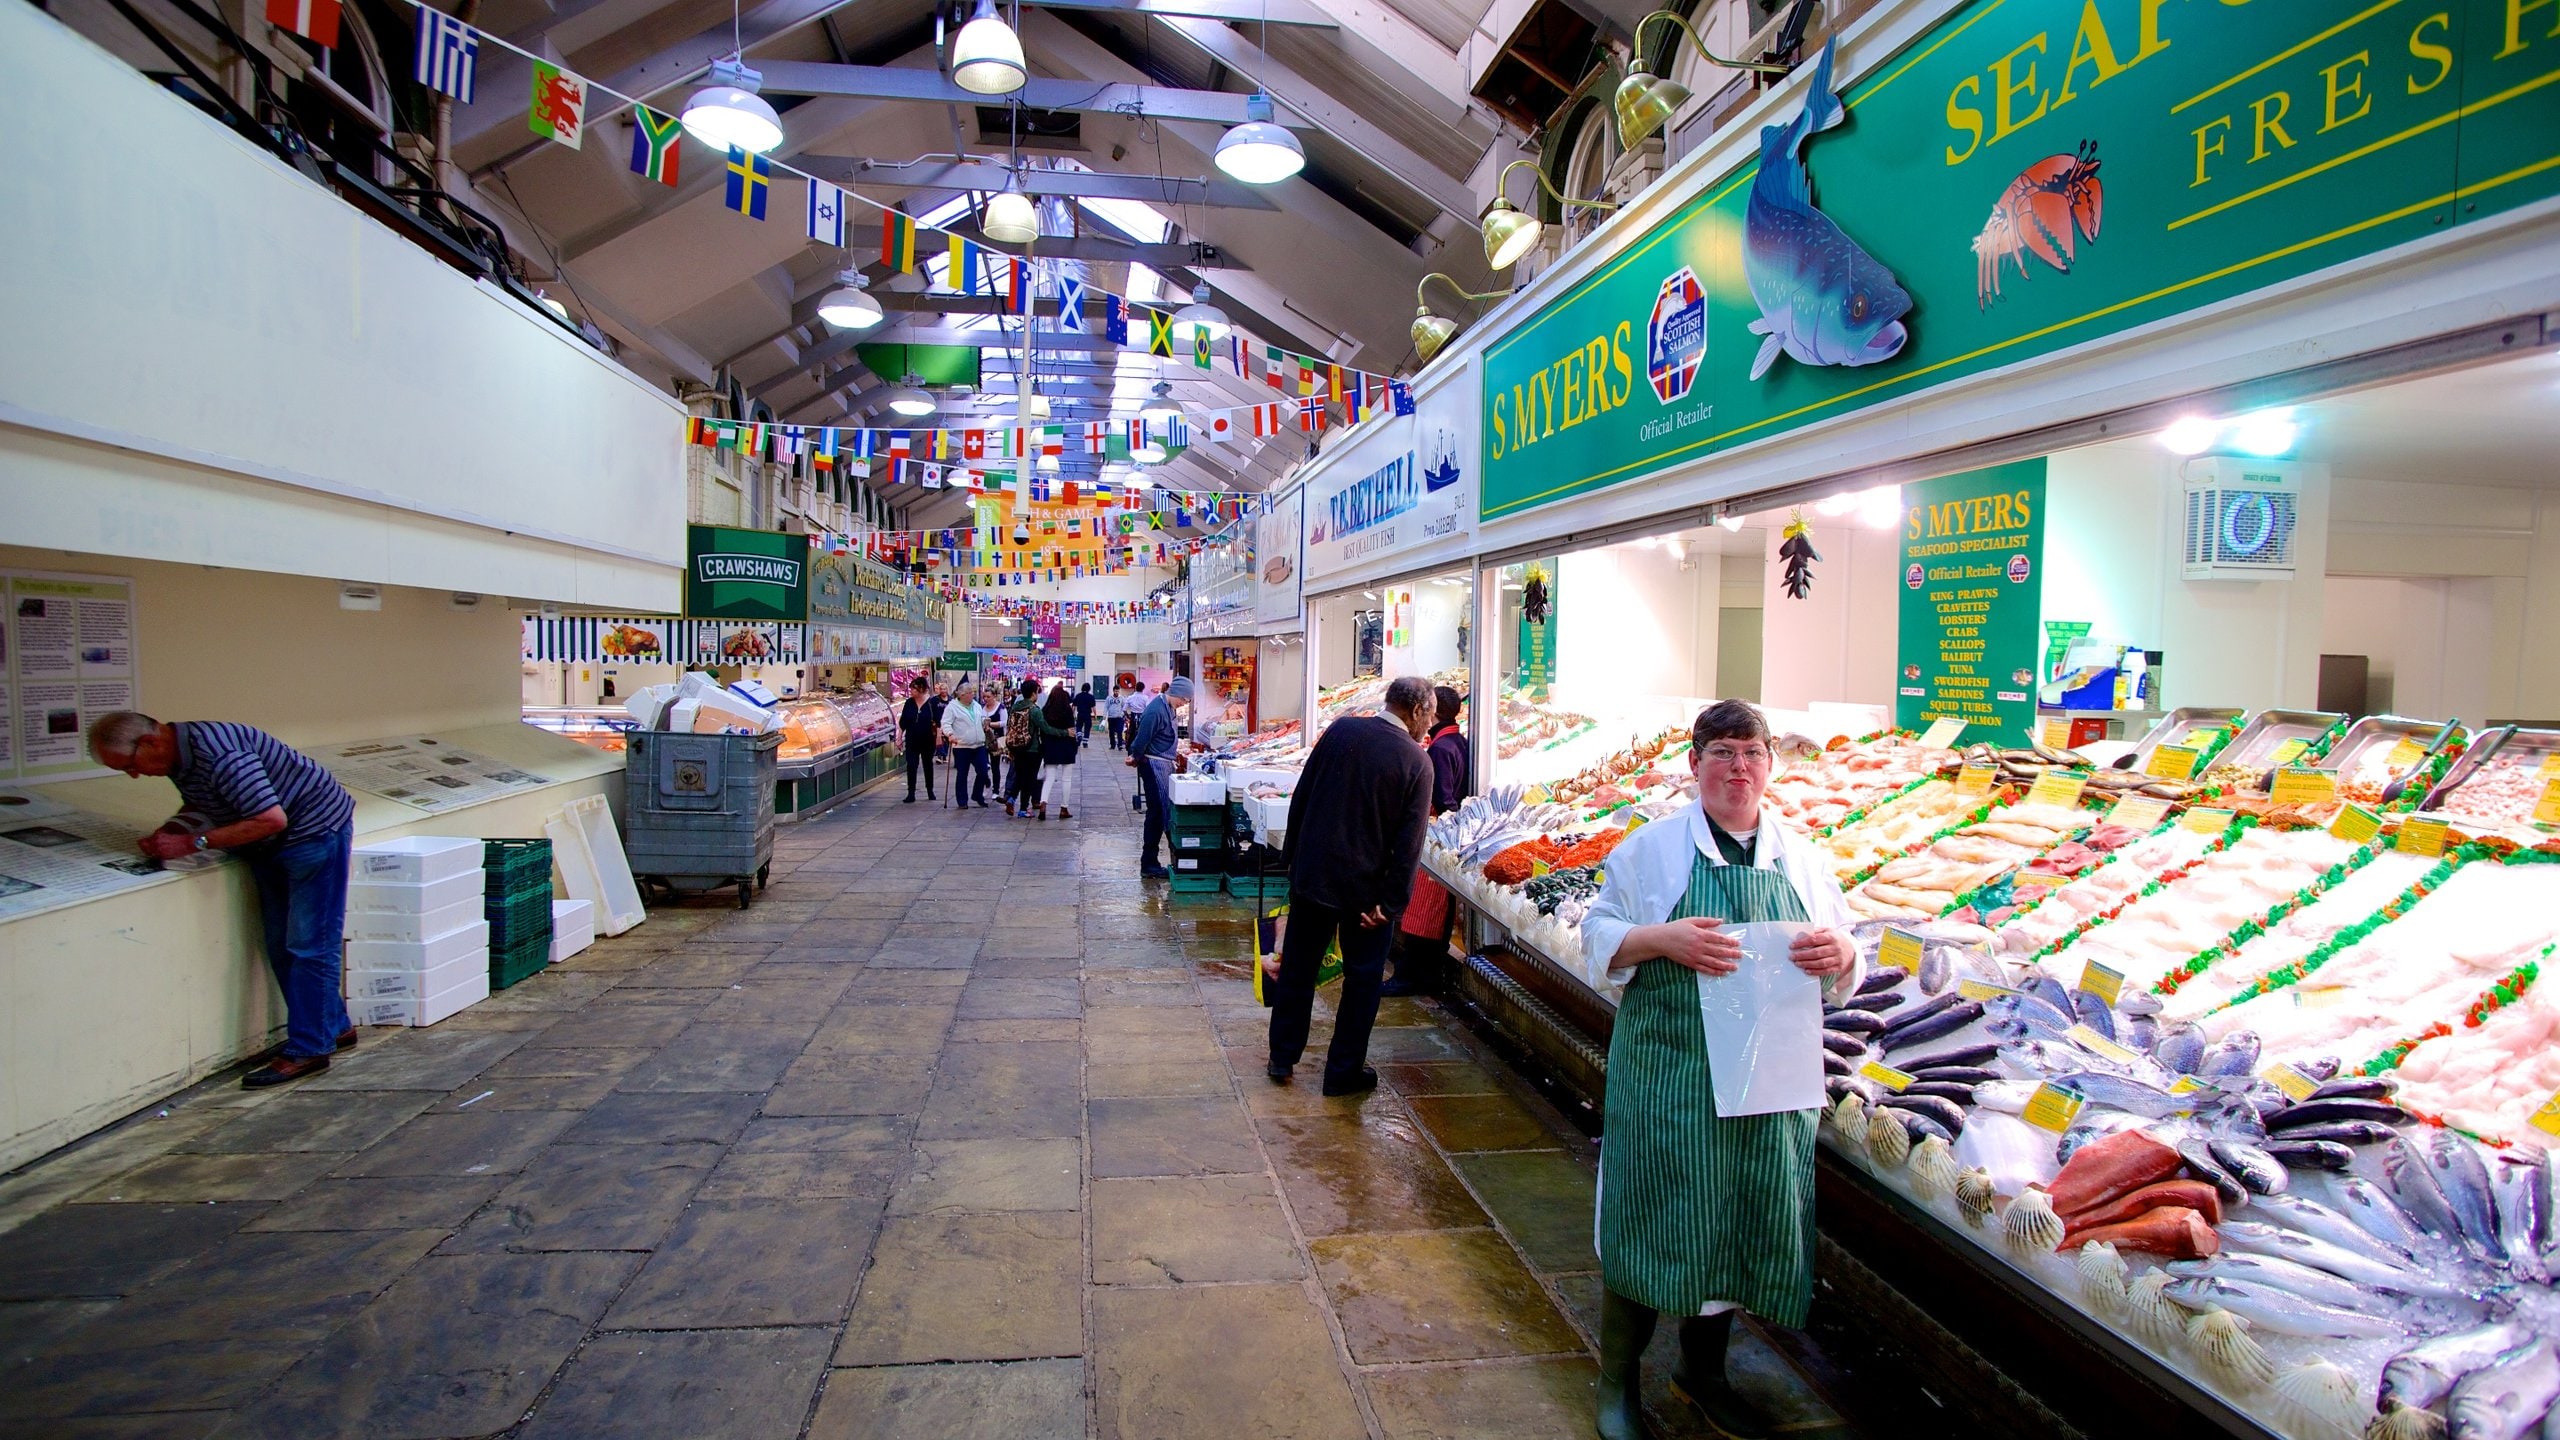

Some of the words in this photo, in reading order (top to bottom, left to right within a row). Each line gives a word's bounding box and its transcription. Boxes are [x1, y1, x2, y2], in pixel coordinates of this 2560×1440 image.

[1946, 0, 2253, 166] SEA
[1663, 315, 1701, 345] SCOTTISH
[1669, 329, 1701, 355] SALMON
[1492, 392, 1506, 460] S
[1512, 320, 1633, 453] MYERS
[1640, 414, 1674, 442] Official
[1676, 402, 1714, 429] Retailer
[1054, 506, 1094, 520] GAME
[1908, 506, 1922, 541] S
[1927, 490, 2031, 538] MYERS
[1036, 519, 1068, 531] RW
[1356, 533, 1380, 558] QUALITY
[1380, 526, 1395, 548] FISH
[1907, 542, 1958, 558] SEAFOOD
[1960, 534, 2030, 553] SPECIALIST
[705, 559, 793, 581] CRAWSHAWS
[1928, 566, 1963, 581] Official
[1966, 563, 2003, 578] Retailer
[1930, 591, 1954, 601] KING
[1957, 588, 1999, 600] PRAWNS
[1939, 614, 1987, 625] LOBSTERS
[1946, 627, 1979, 637] CRABS
[1939, 639, 1985, 650] SCALLOPS
[1941, 652, 1984, 662] HALIBUT
[1948, 664, 1974, 674] TUNA
[1933, 676, 1990, 687] SWORDFISH
[1937, 688, 1984, 699] SARDINES
[1929, 700, 1959, 712] SQUID
[1962, 702, 1993, 713] TUBES
[1962, 714, 2002, 726] SALMON
